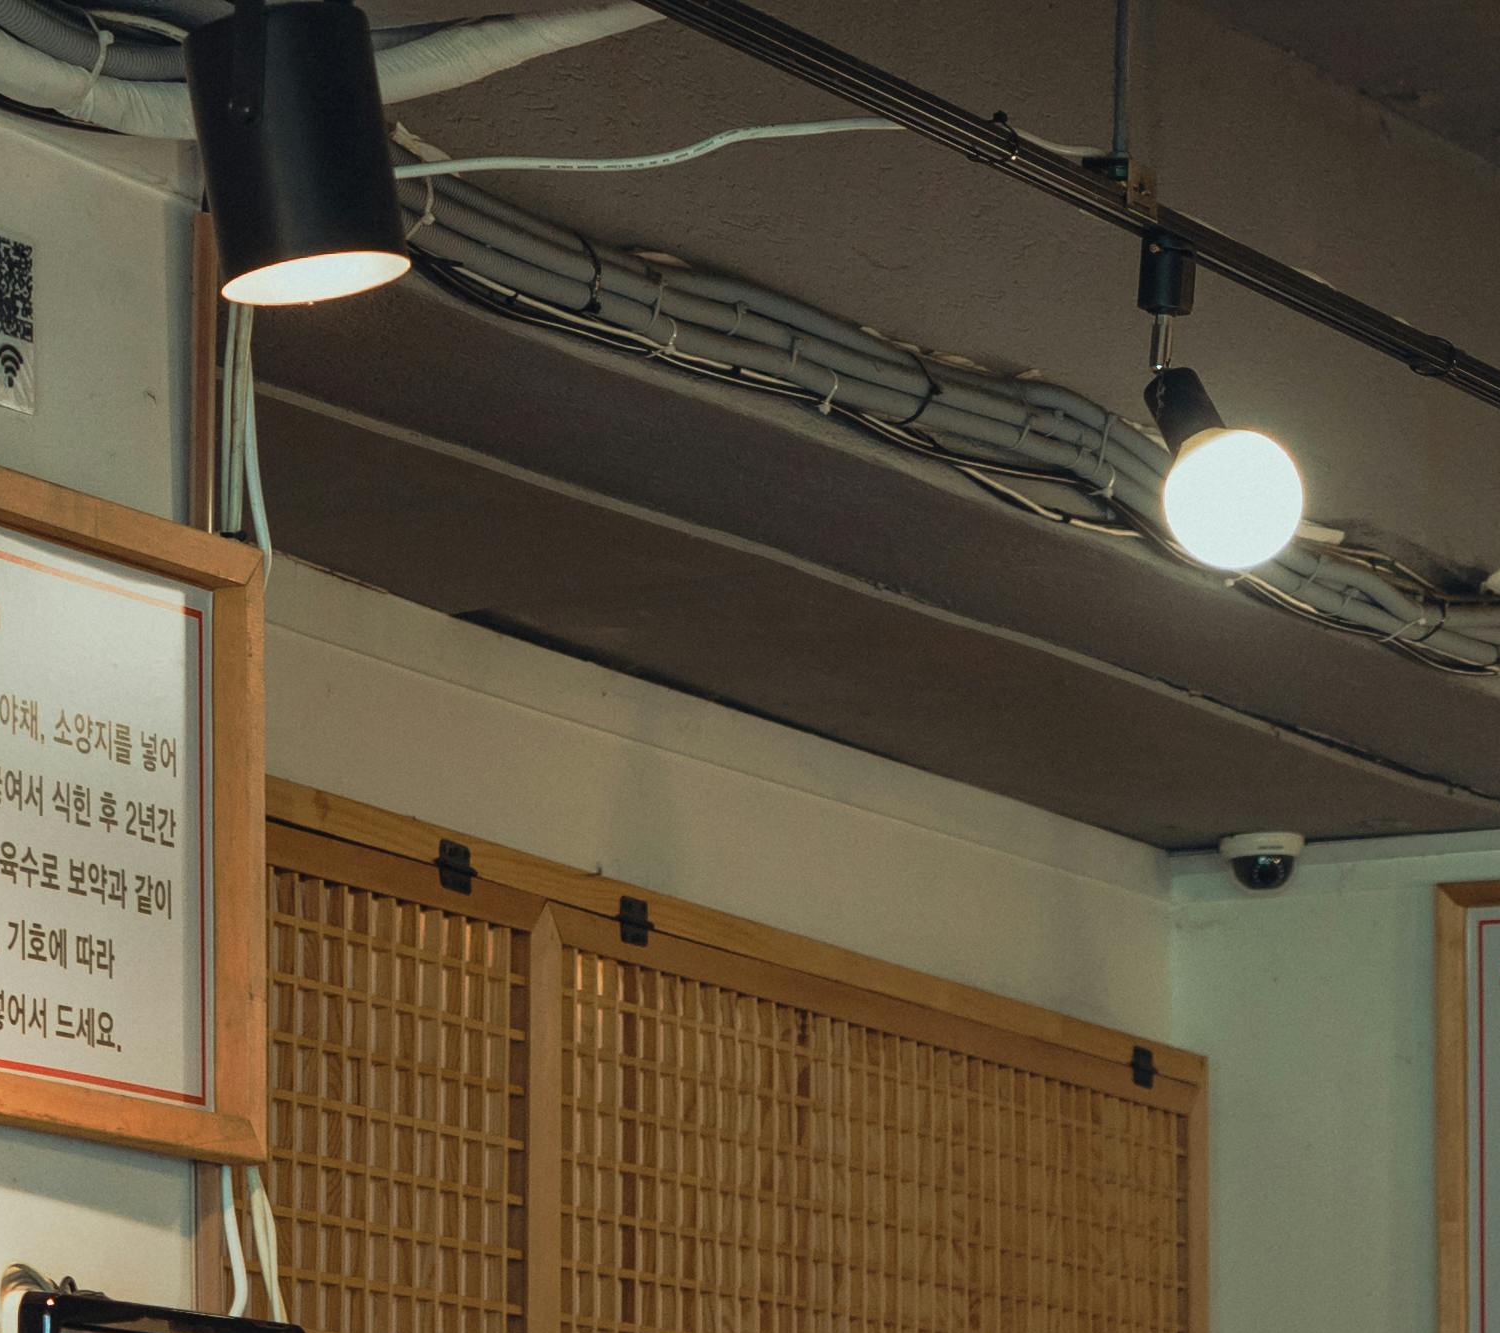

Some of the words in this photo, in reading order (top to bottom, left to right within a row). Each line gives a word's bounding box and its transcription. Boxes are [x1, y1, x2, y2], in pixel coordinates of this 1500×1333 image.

[0, 694, 45, 745] 야채,
[53, 709, 132, 765] 소양지를
[141, 730, 178, 778] 넣어
[51, 780, 92, 827] 식힌
[98, 791, 119, 833] 후
[125, 801, 177, 848] 2년간
[67, 859, 128, 911] 보약과
[134, 874, 173, 920] 같이
[7, 919, 68, 969] 기호에
[76, 934, 116, 979] 따라
[55, 1004, 122, 1052] 드세요.
